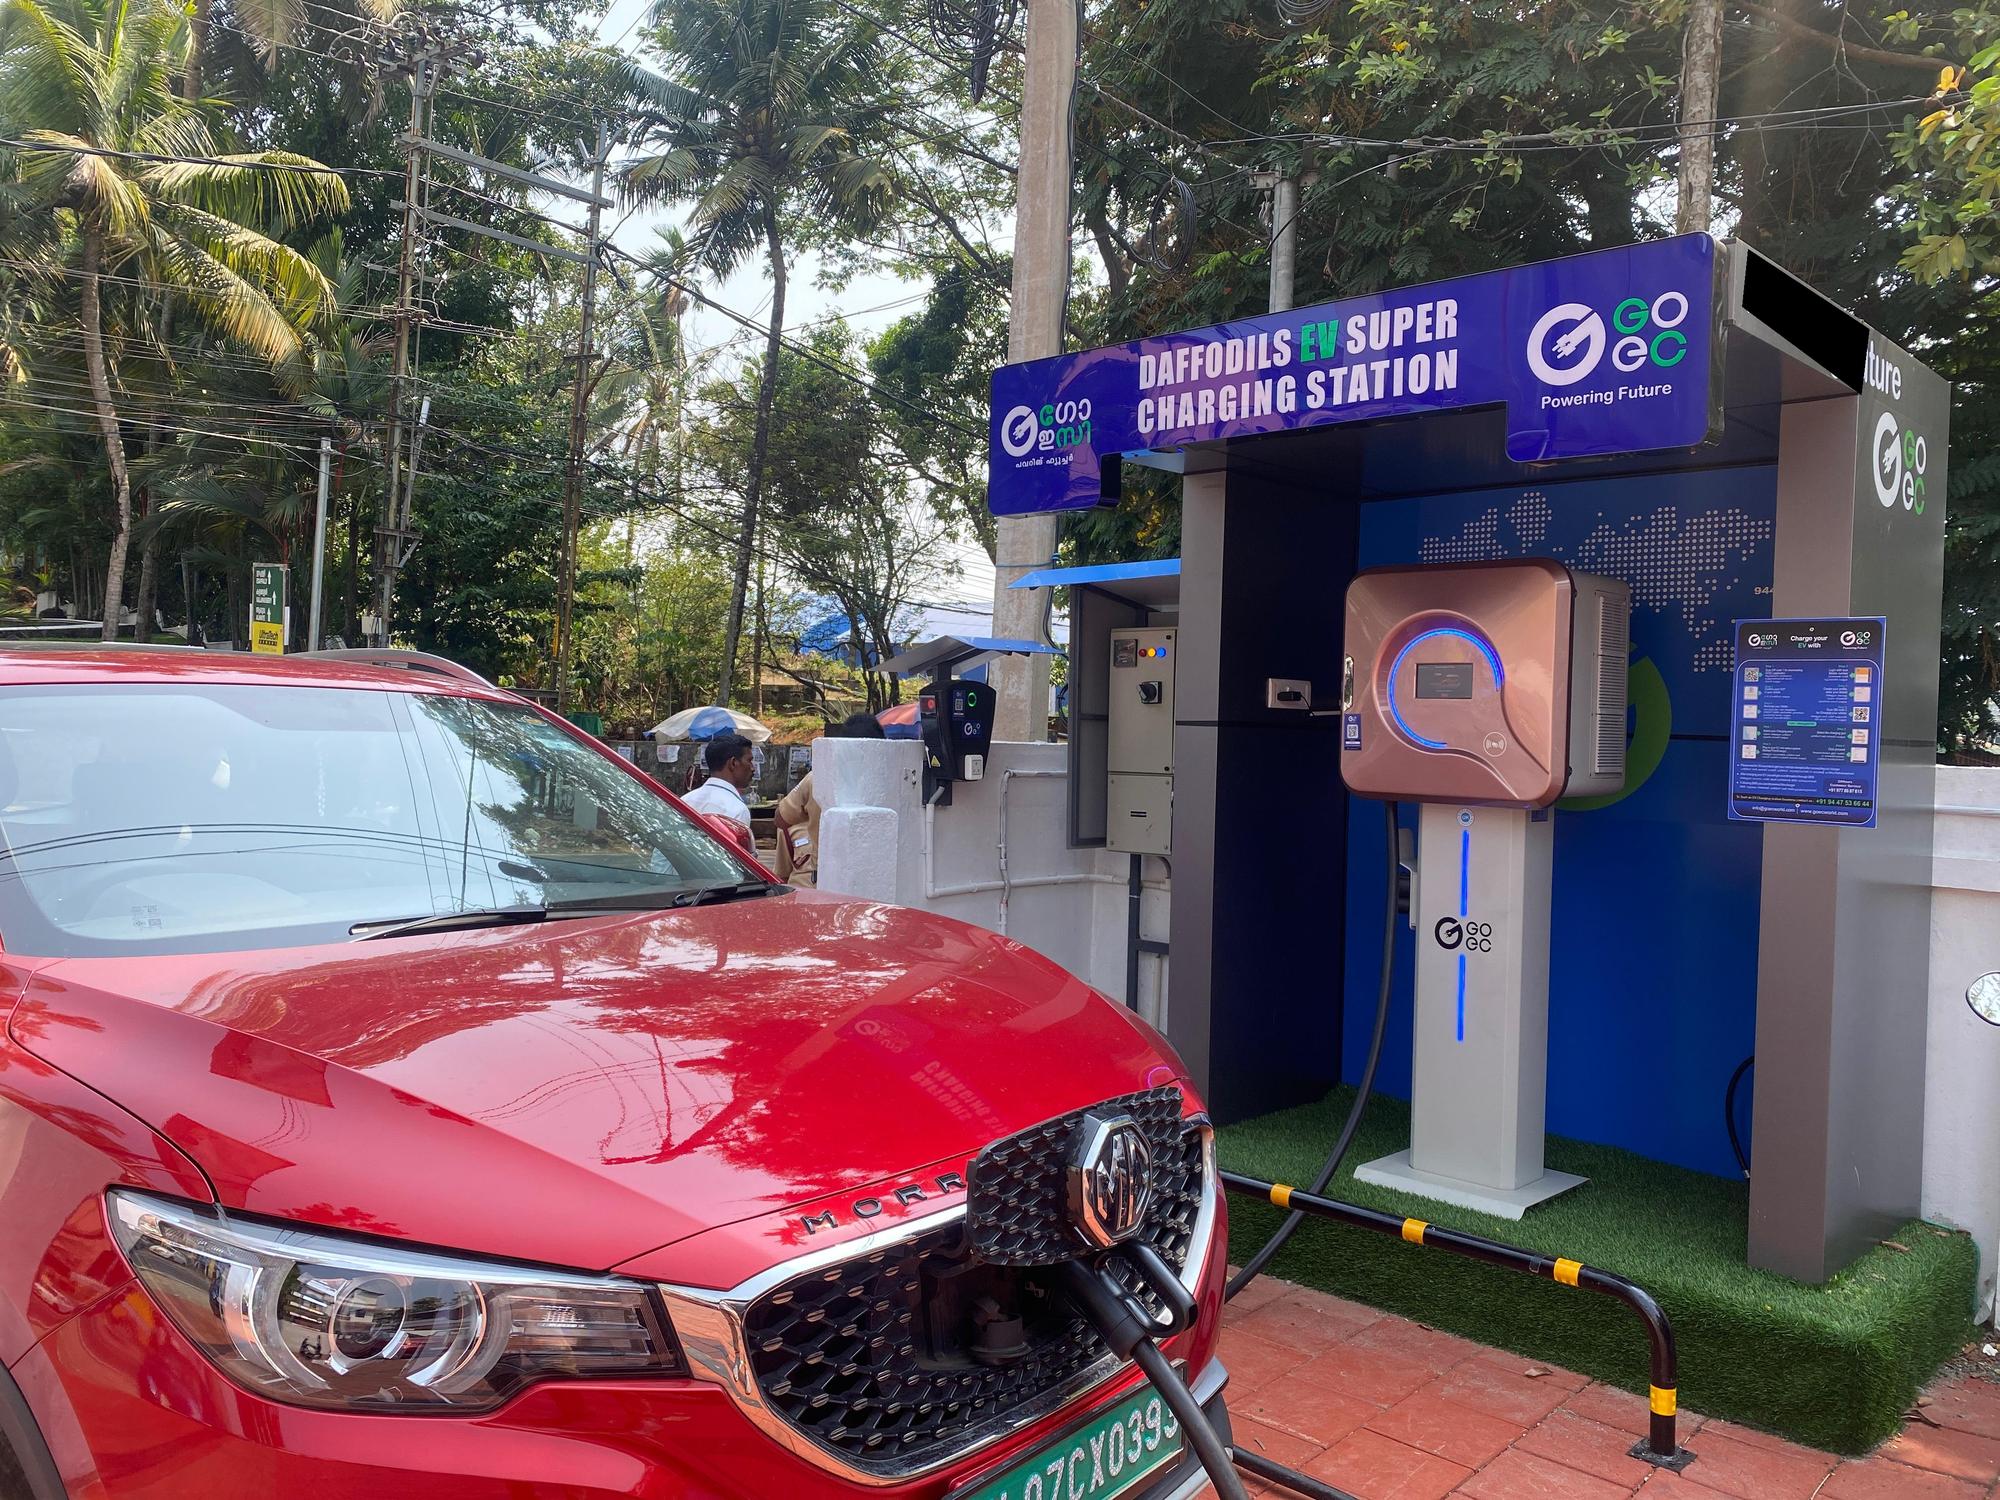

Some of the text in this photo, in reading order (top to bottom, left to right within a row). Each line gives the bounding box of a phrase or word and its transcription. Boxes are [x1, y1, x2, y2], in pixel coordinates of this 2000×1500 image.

[1139, 298, 1460, 391] DAFFODILS EV SUPER
[1137, 348, 1459, 434] CHARGING STATION
[1541, 382, 1672, 410] Powering Future
[1001, 1398, 1178, 1500] 07CX039
